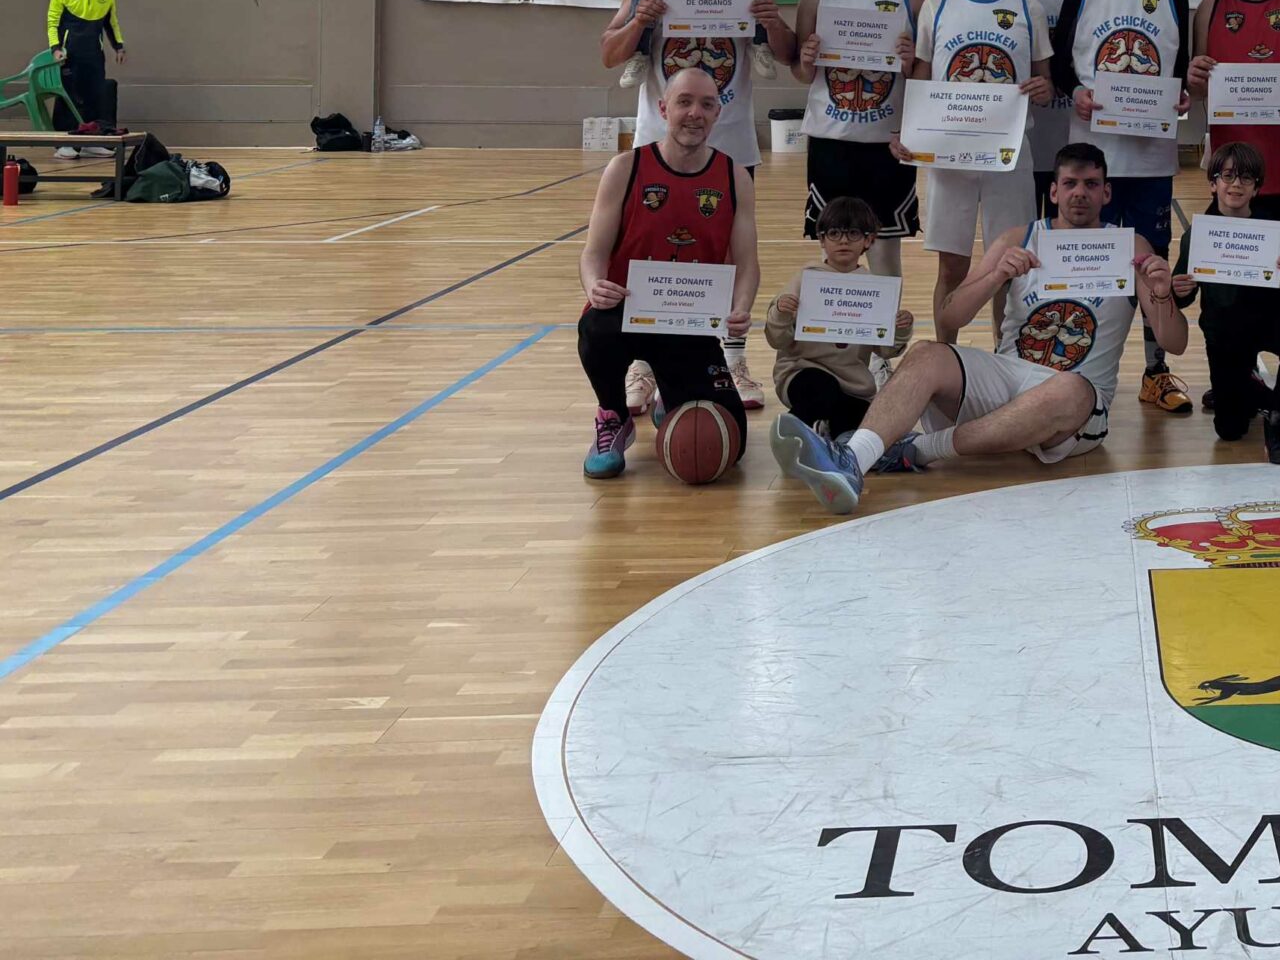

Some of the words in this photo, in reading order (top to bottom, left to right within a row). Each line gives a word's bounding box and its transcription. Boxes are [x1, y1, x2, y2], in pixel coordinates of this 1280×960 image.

[1092, 20, 1112, 39] THE
[1113, 15, 1161, 37] CHICKEN
[944, 34, 965, 52] THE
[967, 30, 1018, 51] CHICKEN
[1110, 85, 1131, 93] HAZTE
[1133, 87, 1163, 96] DONANTE
[930, 92, 953, 100] HAZTE
[955, 93, 990, 102] DONANTE
[825, 104, 894, 123] BROTHERS
[1208, 230, 1230, 238] HAZTE
[1232, 232, 1265, 241] DONANTE
[1056, 243, 1079, 251] HAZTE
[1081, 242, 1115, 251] DONANTE
[1062, 255, 1072, 263] DE
[648, 276, 673, 284] HAZTE
[676, 277, 713, 286] DONANTE
[819, 287, 843, 296] HAZTE
[845, 288, 881, 298] DONANTE
[824, 299, 834, 307] DE
